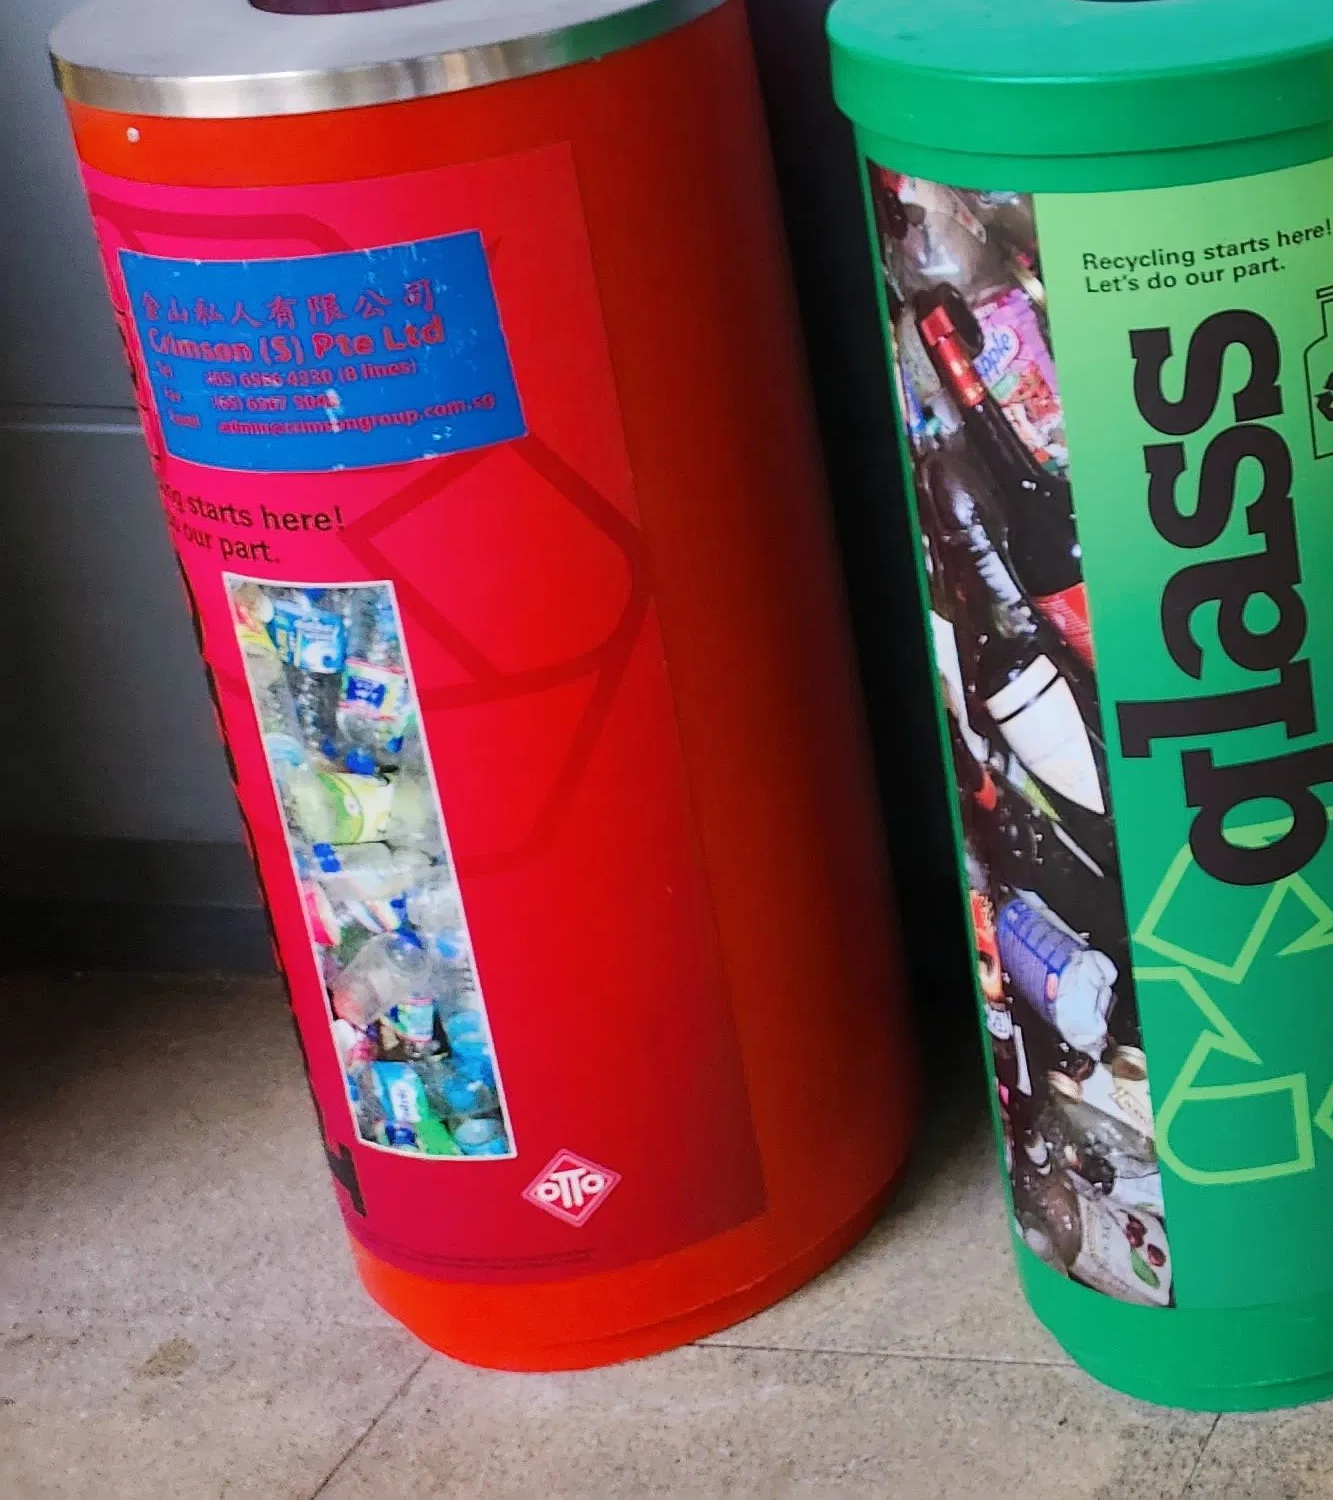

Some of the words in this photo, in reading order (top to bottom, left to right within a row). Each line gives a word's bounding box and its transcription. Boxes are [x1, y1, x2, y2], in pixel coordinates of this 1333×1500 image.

[1082, 248, 1196, 272] Recycling
[1203, 237, 1270, 261] starts
[1276, 218, 1332, 248] here!
[1085, 273, 1140, 293] Let's
[1147, 272, 1177, 290] do
[1185, 267, 1225, 286] our
[1232, 256, 1286, 283] part.
[312, 332, 374, 360] Pte
[382, 314, 446, 350] Ltd
[187, 495, 253, 529] starts
[260, 503, 345, 532] here!
[219, 536, 281, 565] part.
[535, 1166, 606, 1209] OTTO
